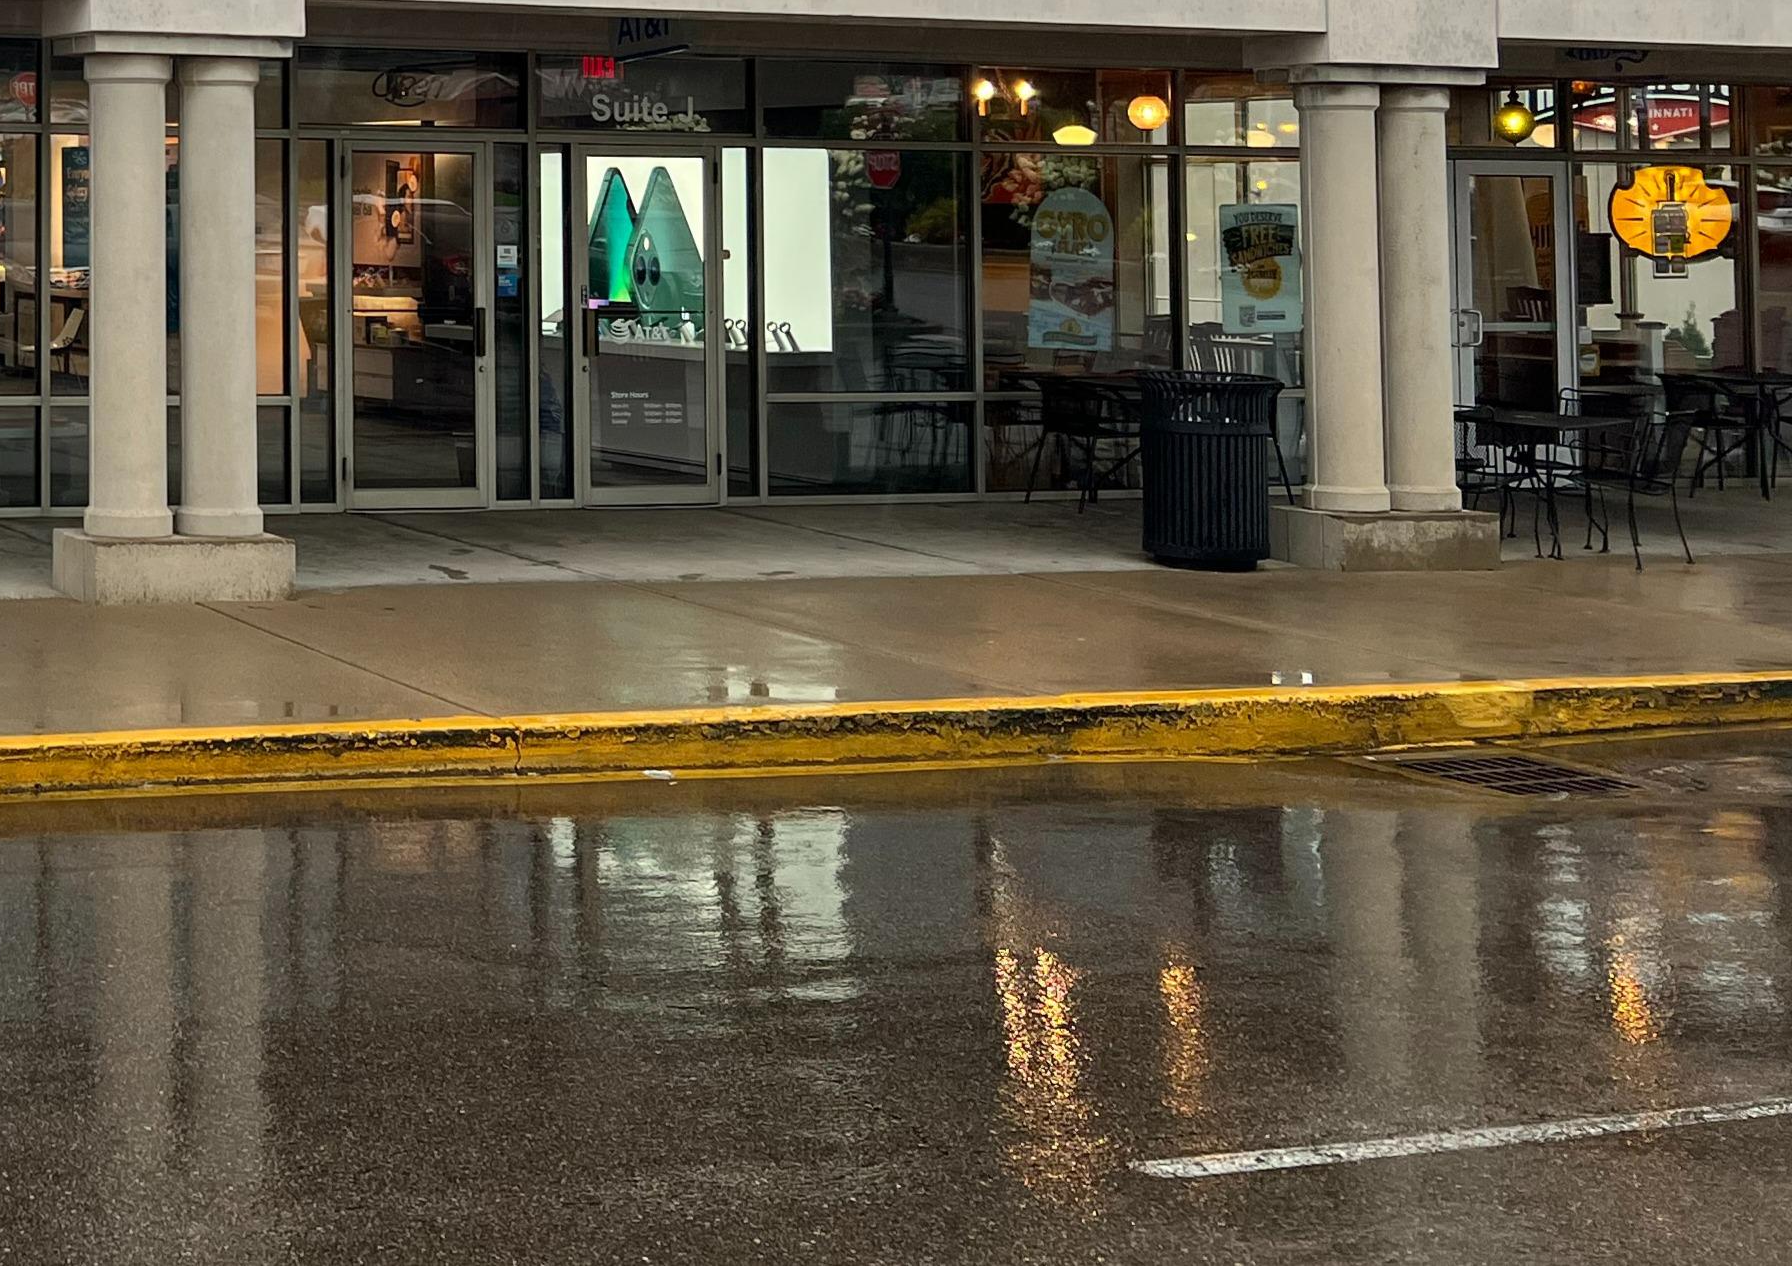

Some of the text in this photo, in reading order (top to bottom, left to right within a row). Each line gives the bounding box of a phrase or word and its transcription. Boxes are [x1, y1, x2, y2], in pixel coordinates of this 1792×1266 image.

[591, 94, 694, 123] Suite J
[1648, 107, 1694, 119] INNATI
